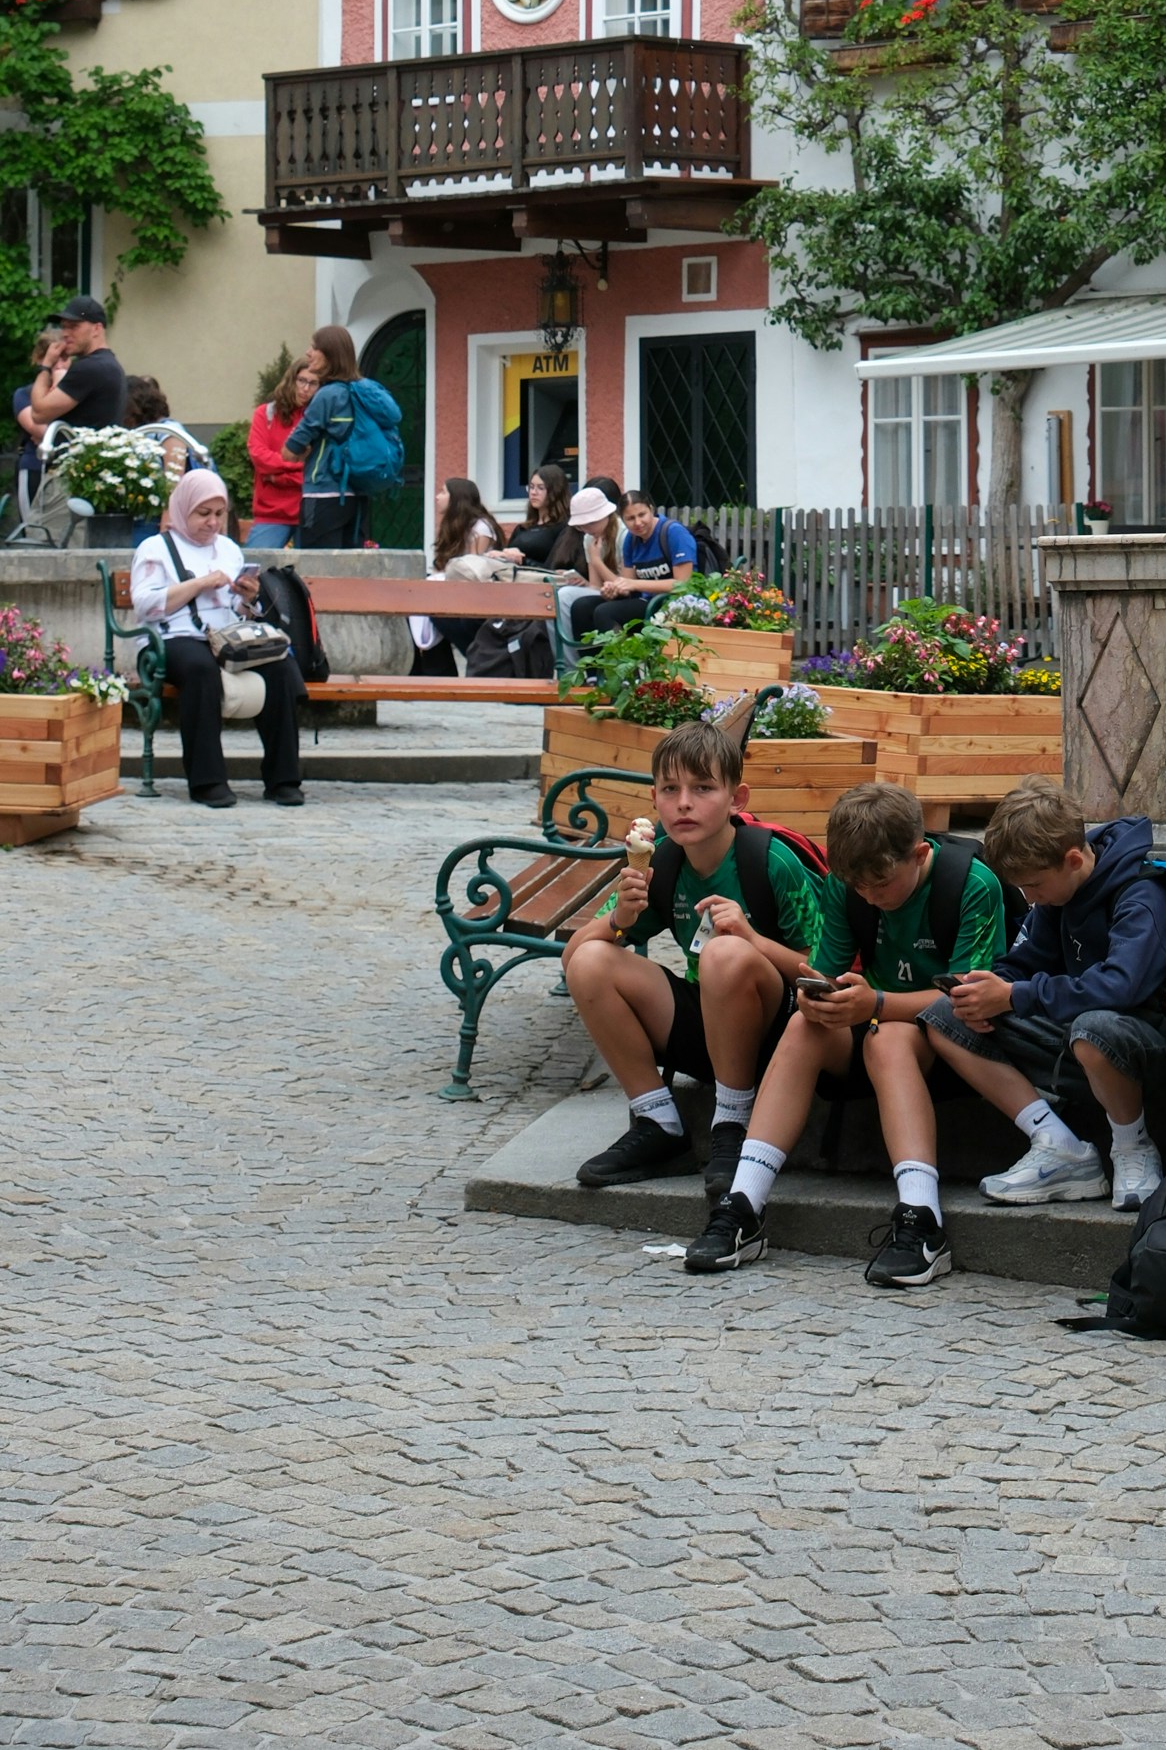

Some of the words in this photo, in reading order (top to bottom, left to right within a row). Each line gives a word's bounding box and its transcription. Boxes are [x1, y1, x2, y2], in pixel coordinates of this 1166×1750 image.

[532, 354, 569, 373] ATM
[635, 562, 671, 580] empa
[897, 959, 913, 982] 21
